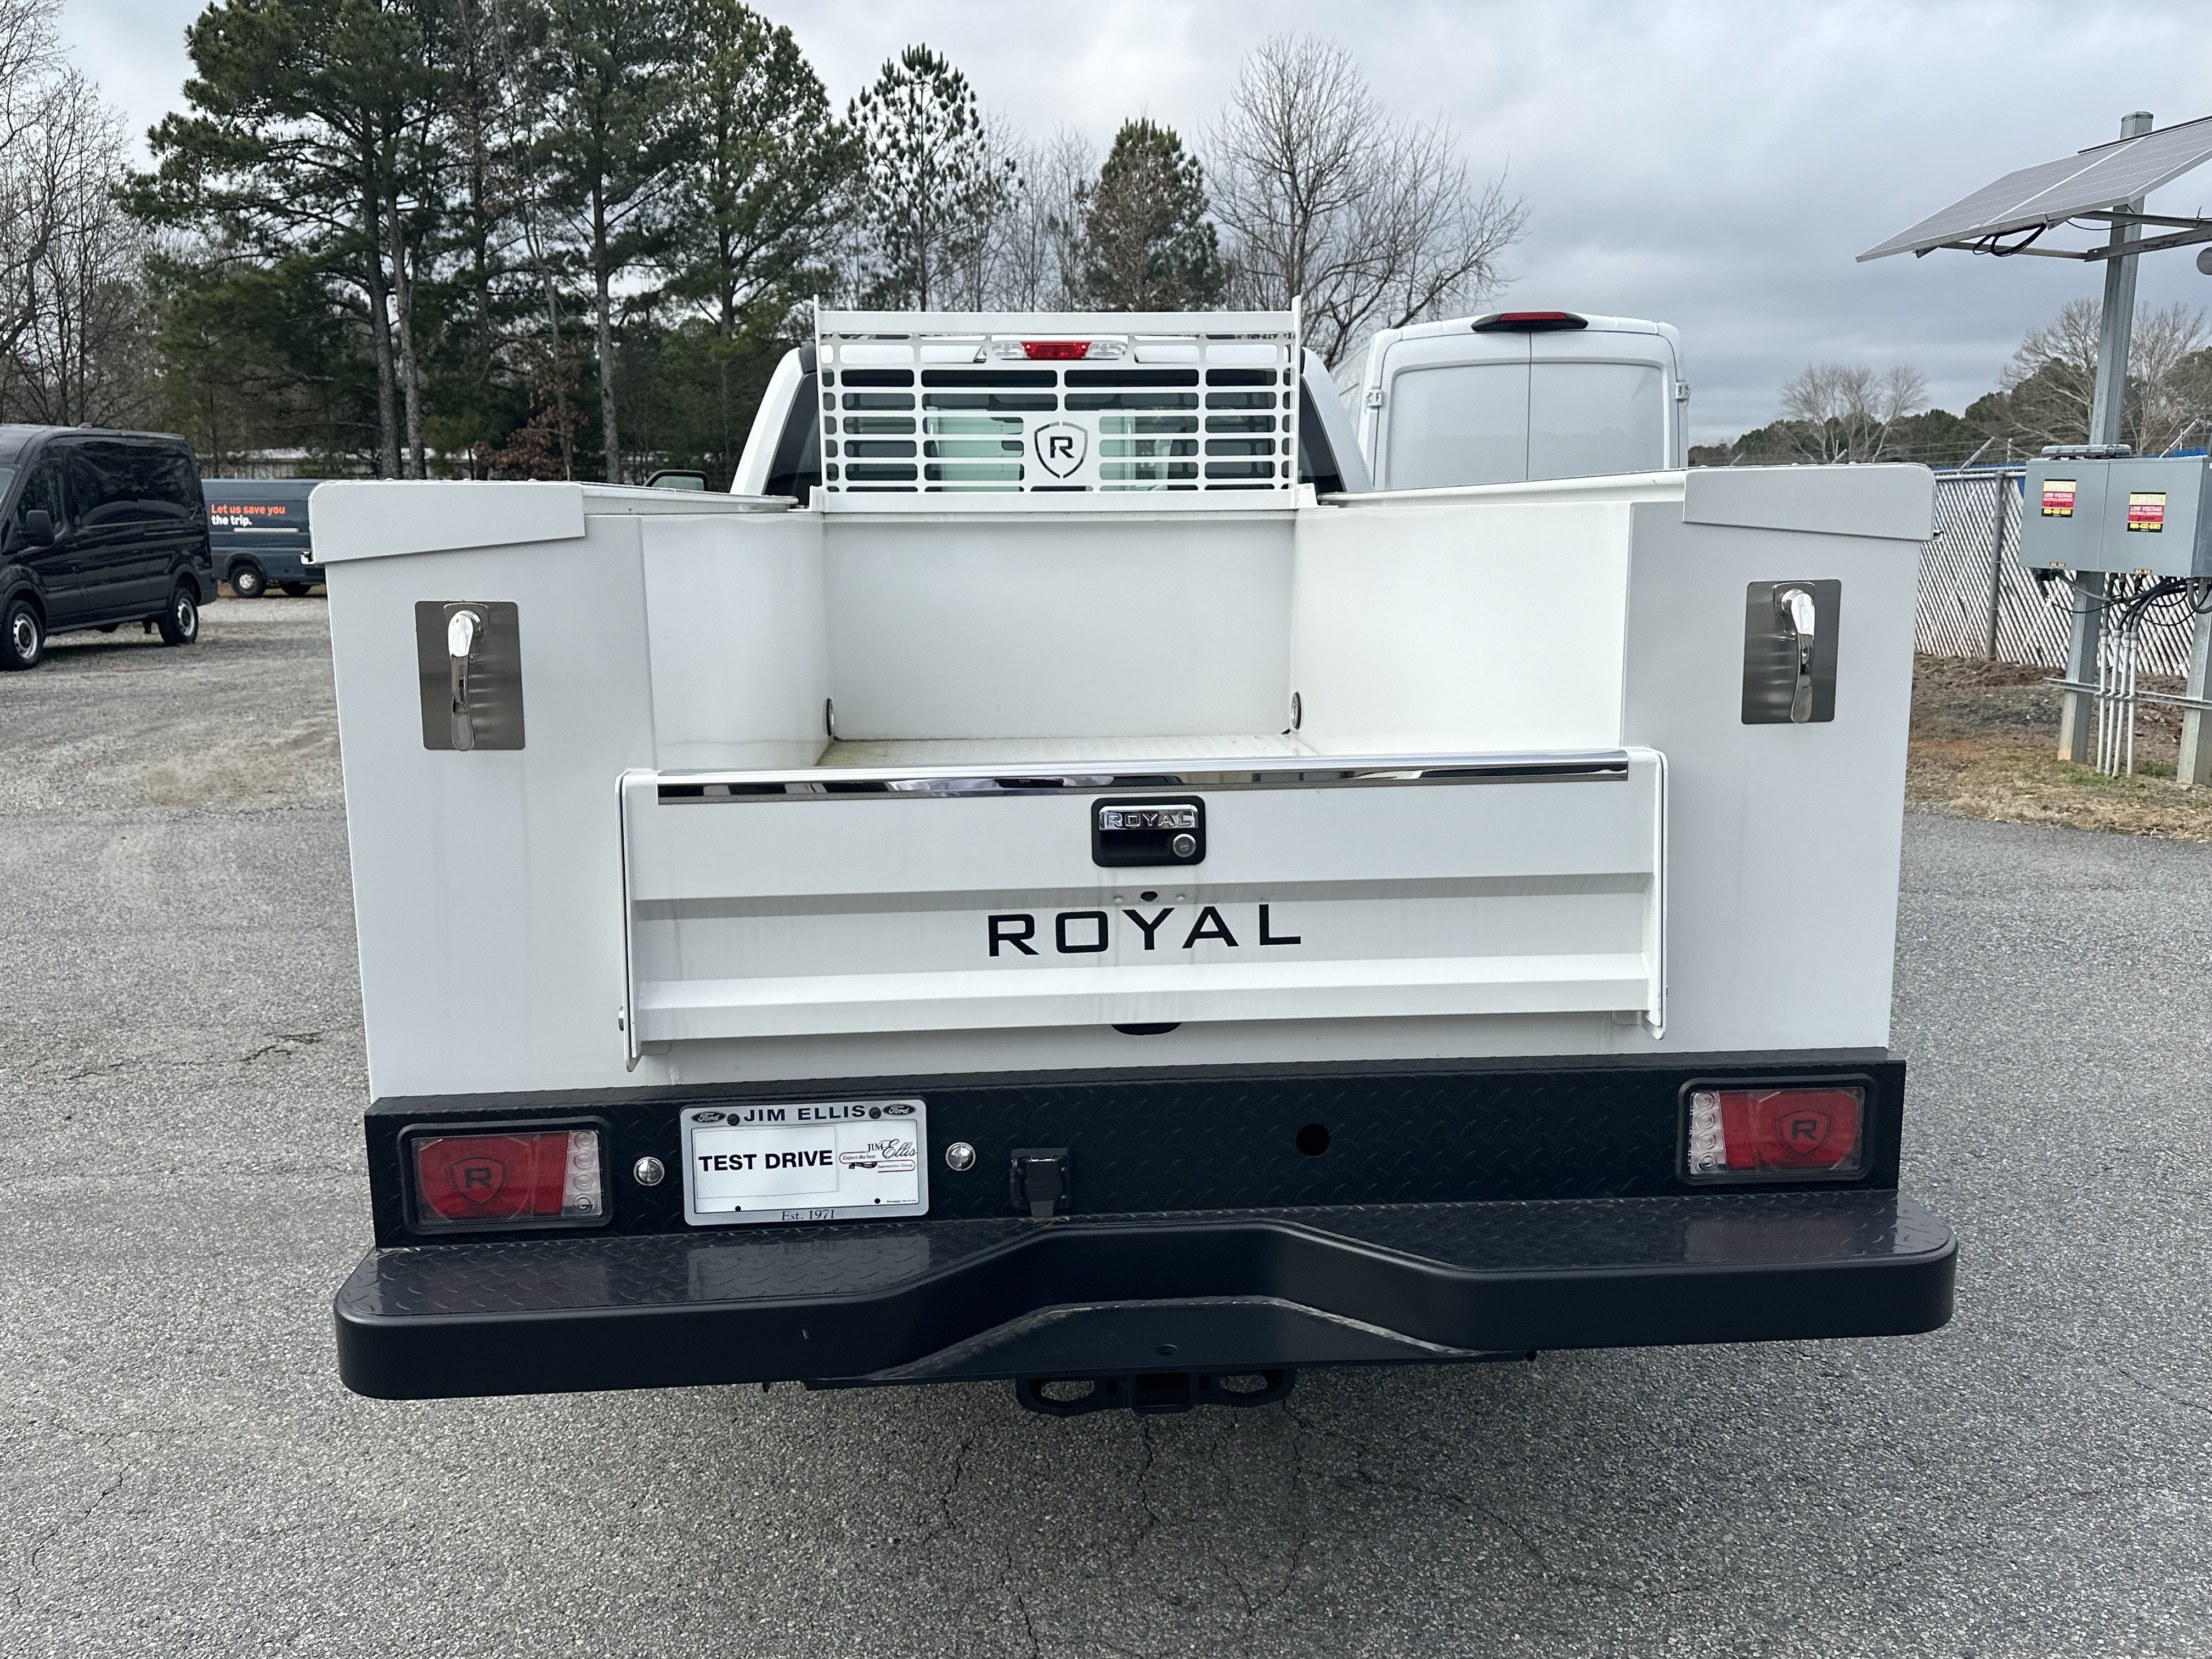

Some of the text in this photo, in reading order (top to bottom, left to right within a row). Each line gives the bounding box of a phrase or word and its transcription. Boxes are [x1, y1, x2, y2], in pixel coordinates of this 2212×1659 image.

[1049, 436, 1075, 458] R
[211, 504, 286, 516] Let us save you
[211, 515, 253, 527] the trip.
[1107, 811, 1192, 827] ROYAL
[988, 904, 1301, 957] ROYAL
[743, 1105, 865, 1121] JIM ELLIS
[1791, 1119, 1817, 1141] R
[867, 1139, 917, 1159] JIM Ellis
[698, 1150, 833, 1171] TEST DRIVE
[464, 1167, 492, 1189] R
[781, 1209, 834, 1221] Est. 1971
